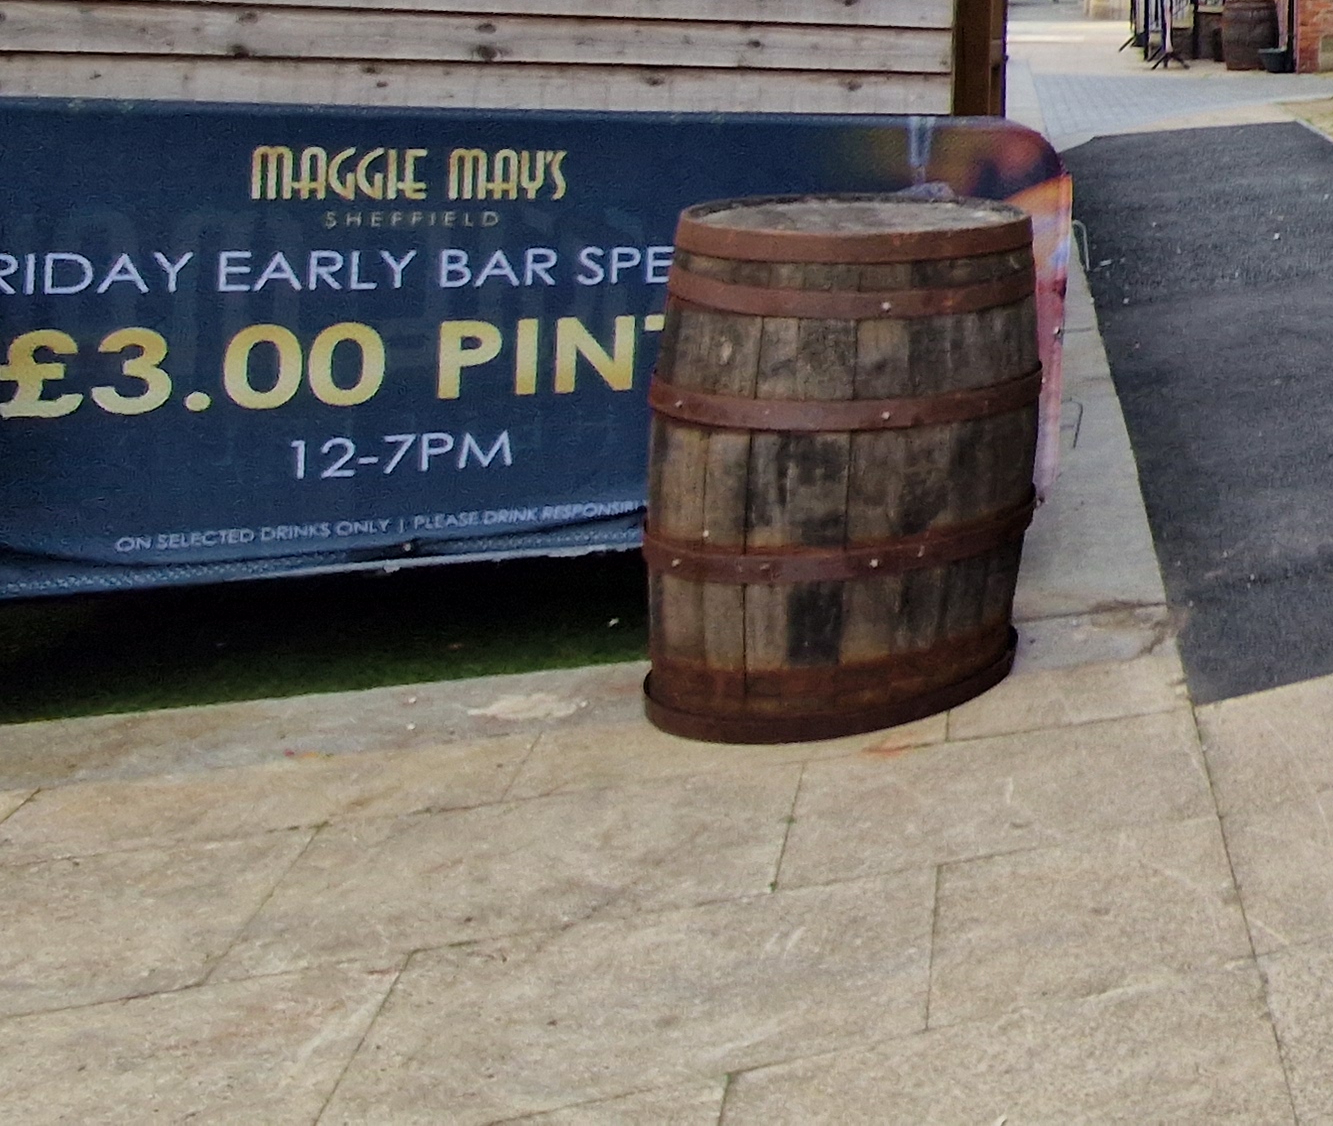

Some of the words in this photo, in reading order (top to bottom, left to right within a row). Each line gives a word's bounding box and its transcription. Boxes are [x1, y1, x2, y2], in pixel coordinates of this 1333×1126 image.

[250, 144, 428, 200] MAGGIE
[448, 146, 568, 201] MAY'S
[324, 211, 500, 229] SHEFFIELD
[217, 250, 418, 293] EARLY
[439, 247, 560, 289] BAR
[0, 322, 386, 419] £3.00
[289, 430, 514, 480] 12-7PM
[114, 535, 151, 553] ON
[156, 528, 255, 551] SELECTED
[260, 521, 331, 542] DRINKS
[336, 518, 393, 537] ONLY
[413, 510, 479, 531] PLEASE
[483, 507, 538, 525] DRINK
